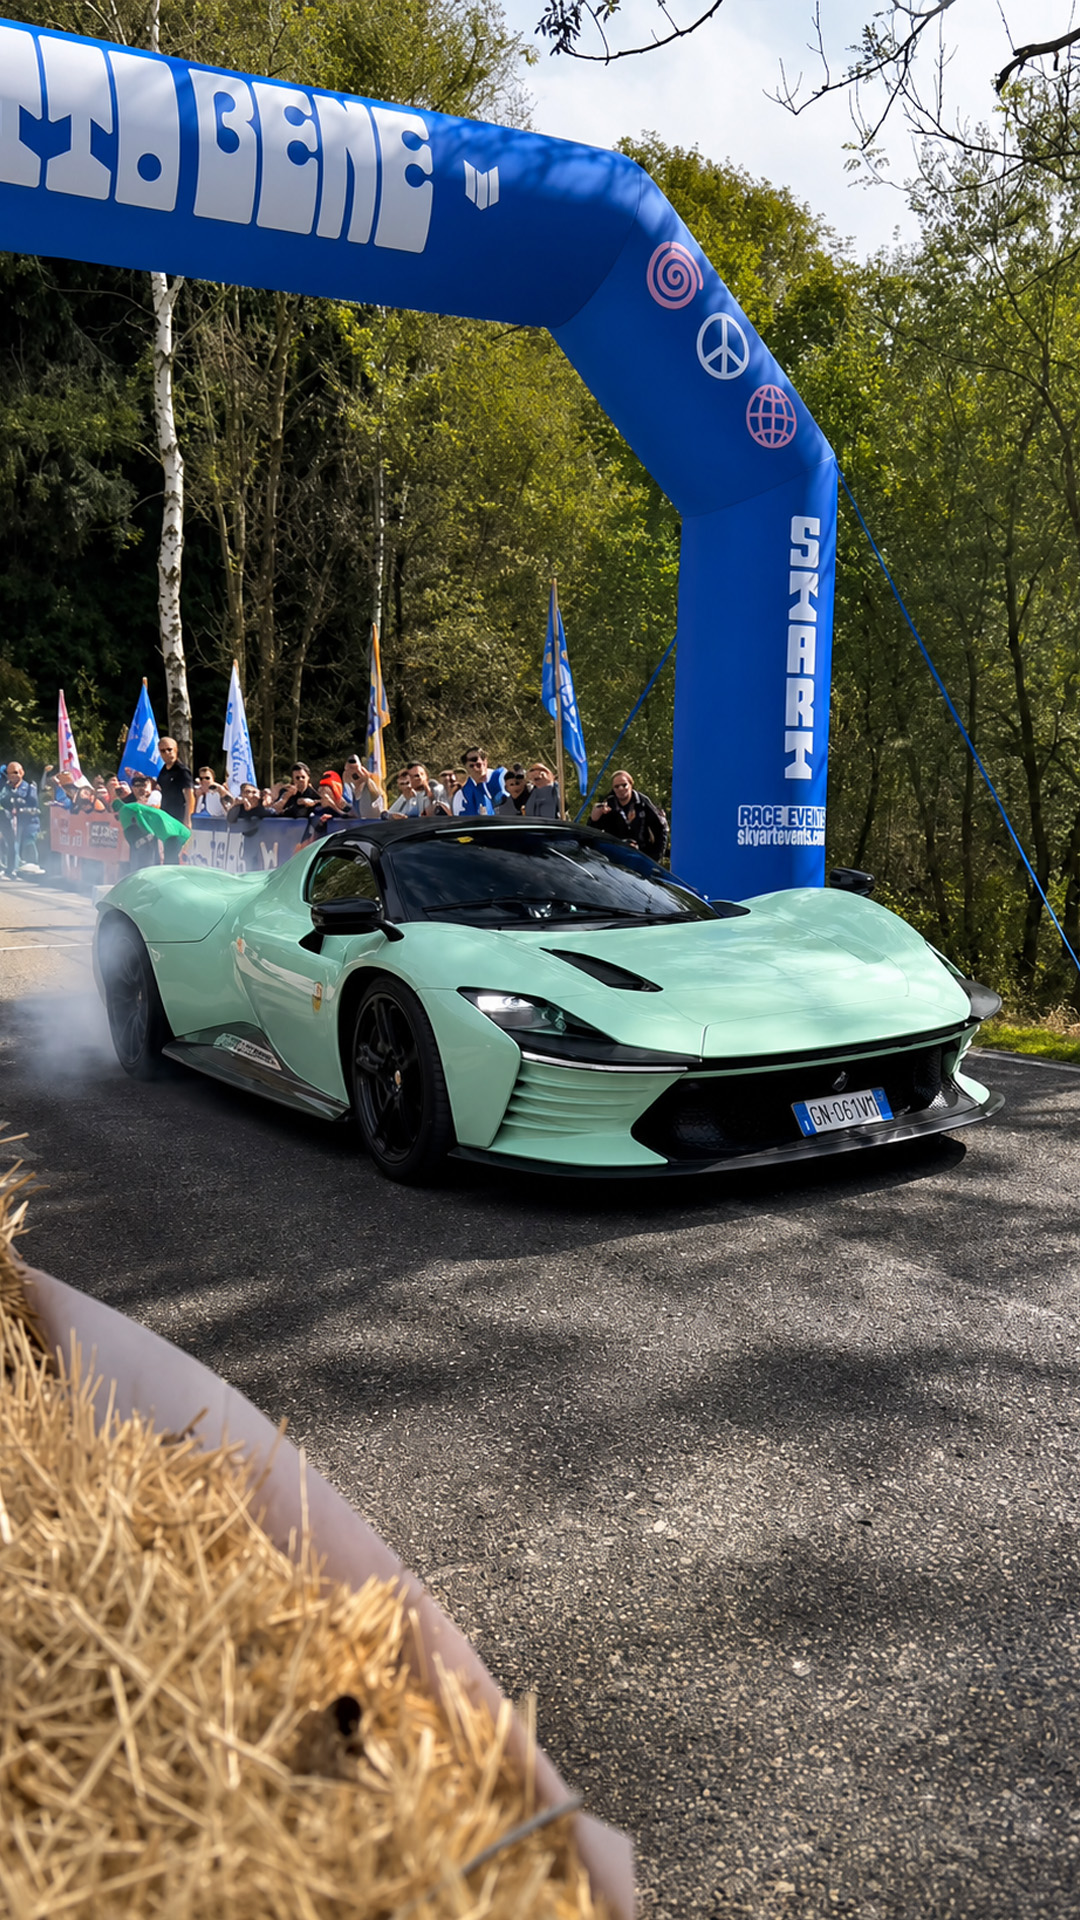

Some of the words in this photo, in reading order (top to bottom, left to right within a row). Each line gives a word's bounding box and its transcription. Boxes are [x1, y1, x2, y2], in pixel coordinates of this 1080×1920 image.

[188, 68, 434, 254] BENE
[738, 805, 783, 827] RACE
[786, 806, 825, 827] EVENTS
